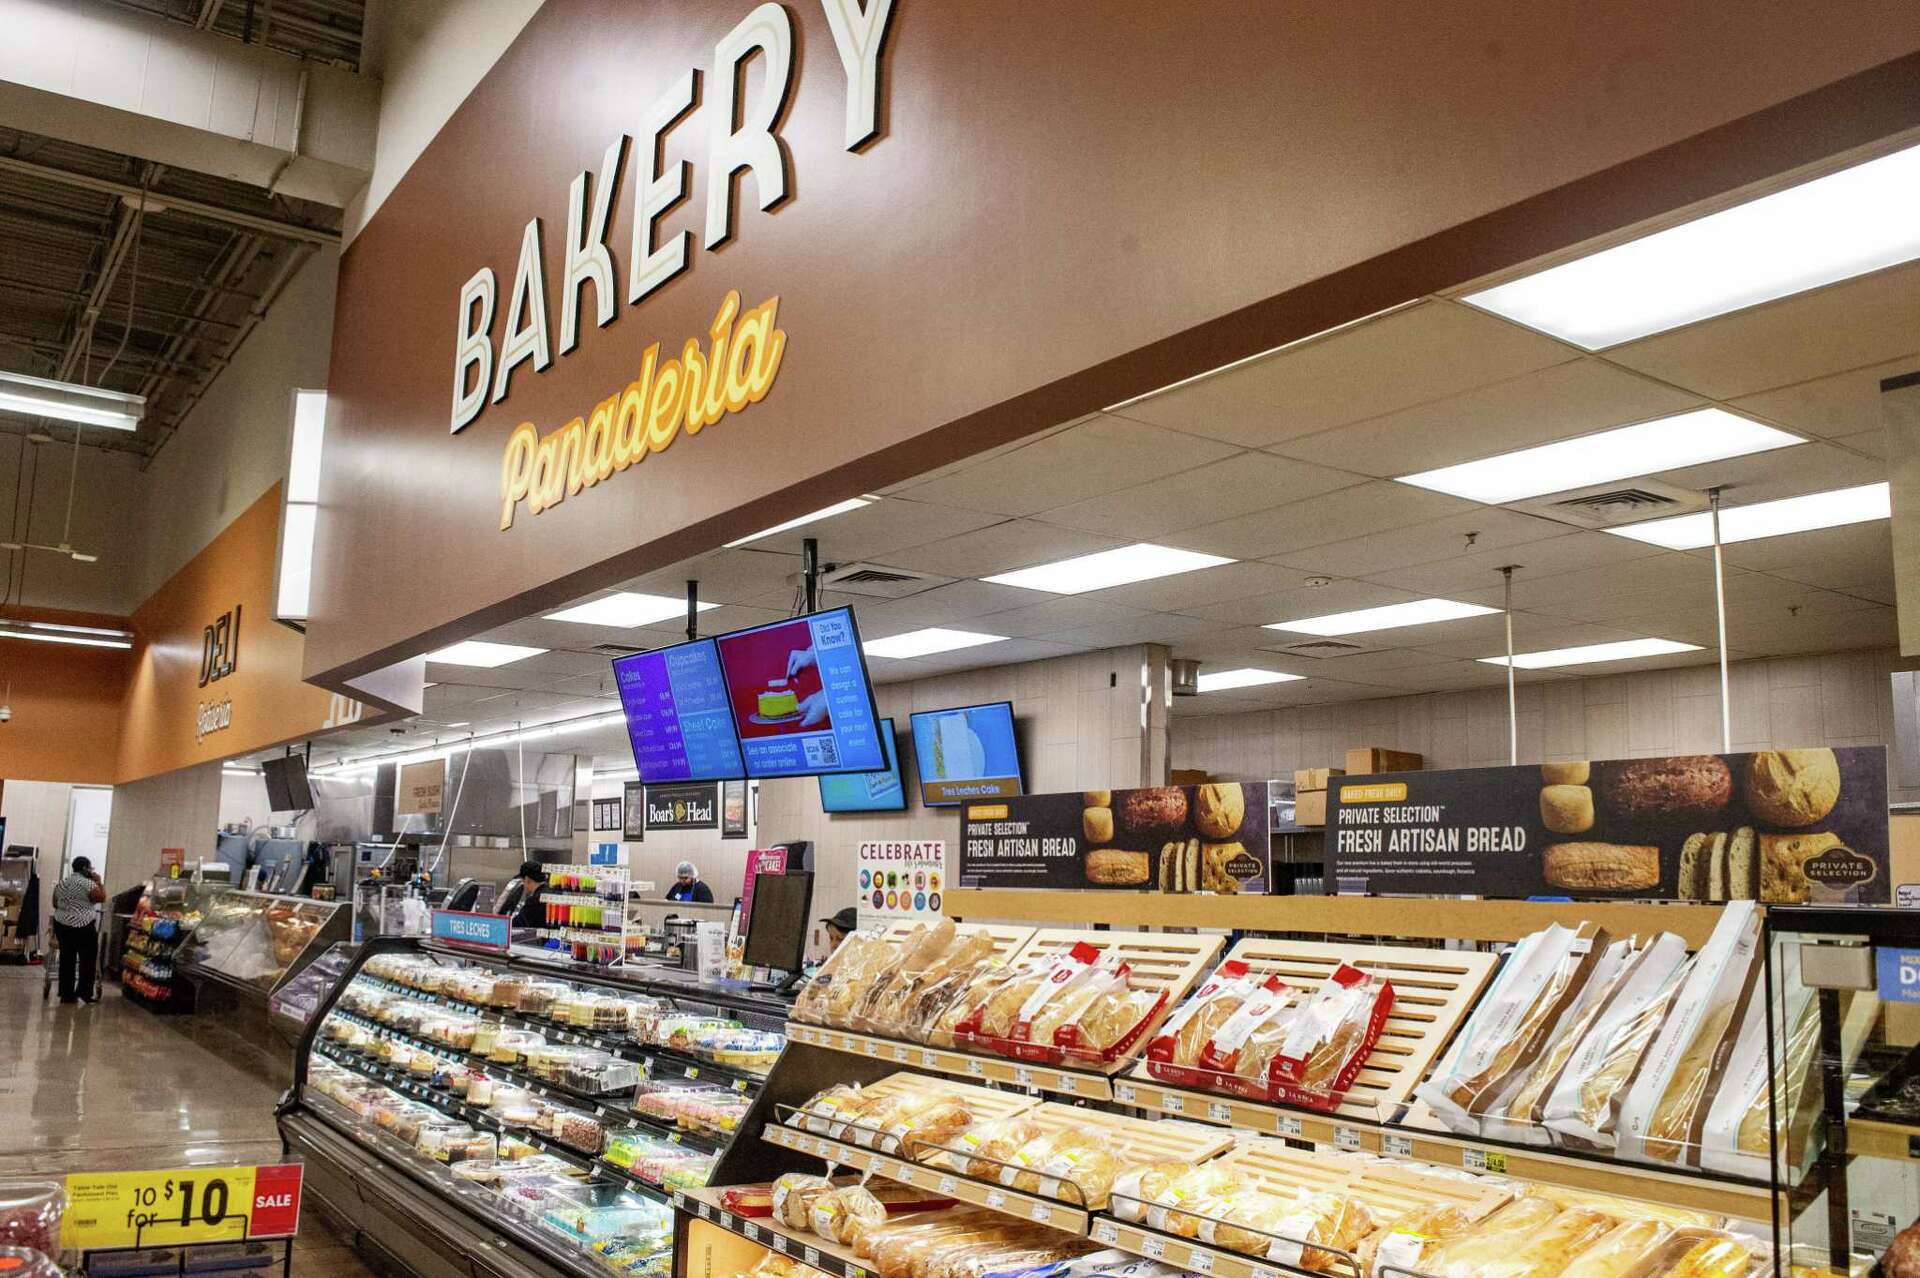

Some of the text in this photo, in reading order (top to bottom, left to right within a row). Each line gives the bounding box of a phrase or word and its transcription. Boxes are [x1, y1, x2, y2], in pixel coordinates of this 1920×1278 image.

[451, 0, 895, 434] BAKERY
[501, 290, 788, 531] Panadería
[199, 605, 242, 688] DELI
[649, 800, 712, 823] Boar's Head
[1339, 808, 1379, 824] PRIVATE
[967, 823, 992, 836] PRIVATE
[967, 837, 1076, 857] FRESH ARTISAN BREAD
[1338, 826, 1526, 853] FRESH ARTISAN BREAD
[860, 843, 942, 860] CELEBRATE
[1812, 862, 1864, 870] PRIVATE
[450, 919, 491, 938] TRES LECHES
[1900, 966, 1920, 985] D
[133, 1187, 156, 1206] 10
[164, 1179, 229, 1227] $10
[255, 1194, 292, 1208] SALE
[127, 1209, 158, 1228] for
